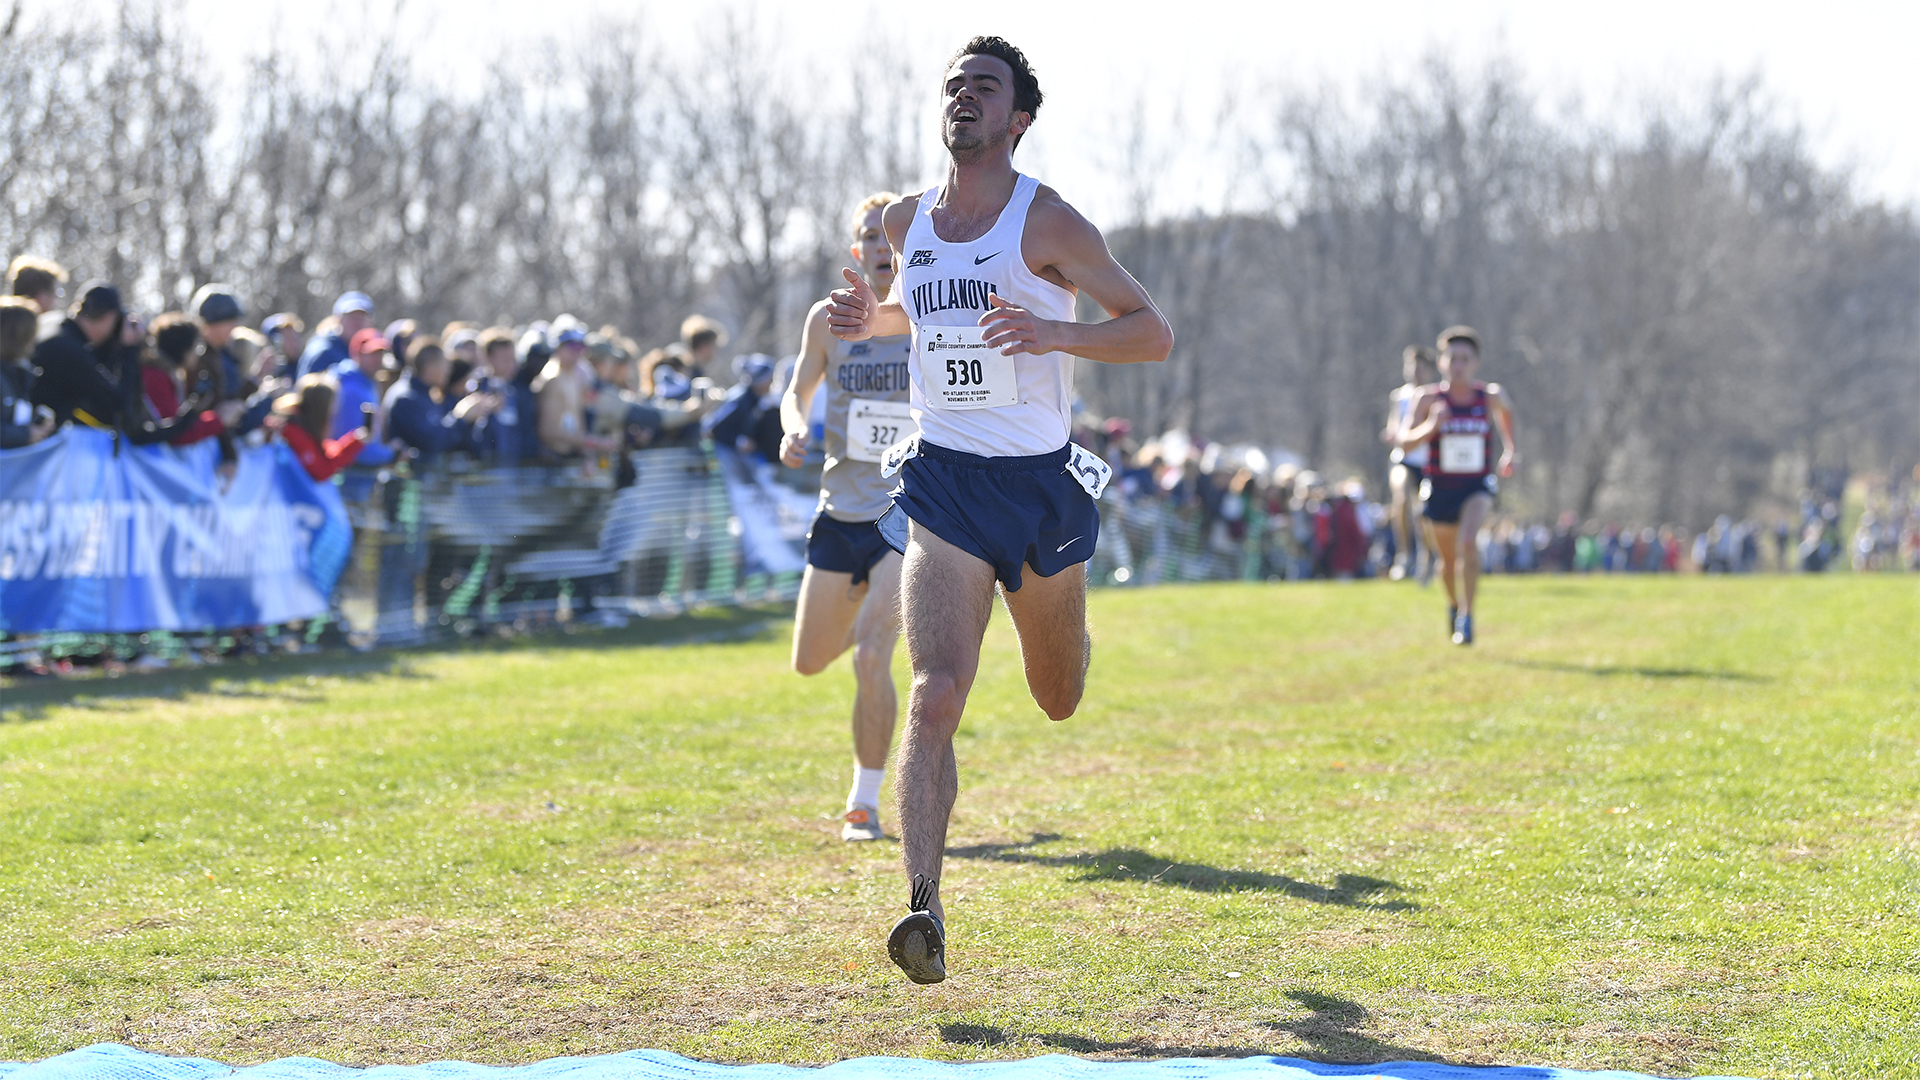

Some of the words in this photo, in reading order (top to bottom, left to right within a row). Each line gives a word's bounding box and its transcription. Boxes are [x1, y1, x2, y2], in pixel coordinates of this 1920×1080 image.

[909, 257, 938, 265] EAST
[912, 250, 933, 258] BIG
[946, 359, 983, 386] 530
[871, 425, 899, 445] 327
